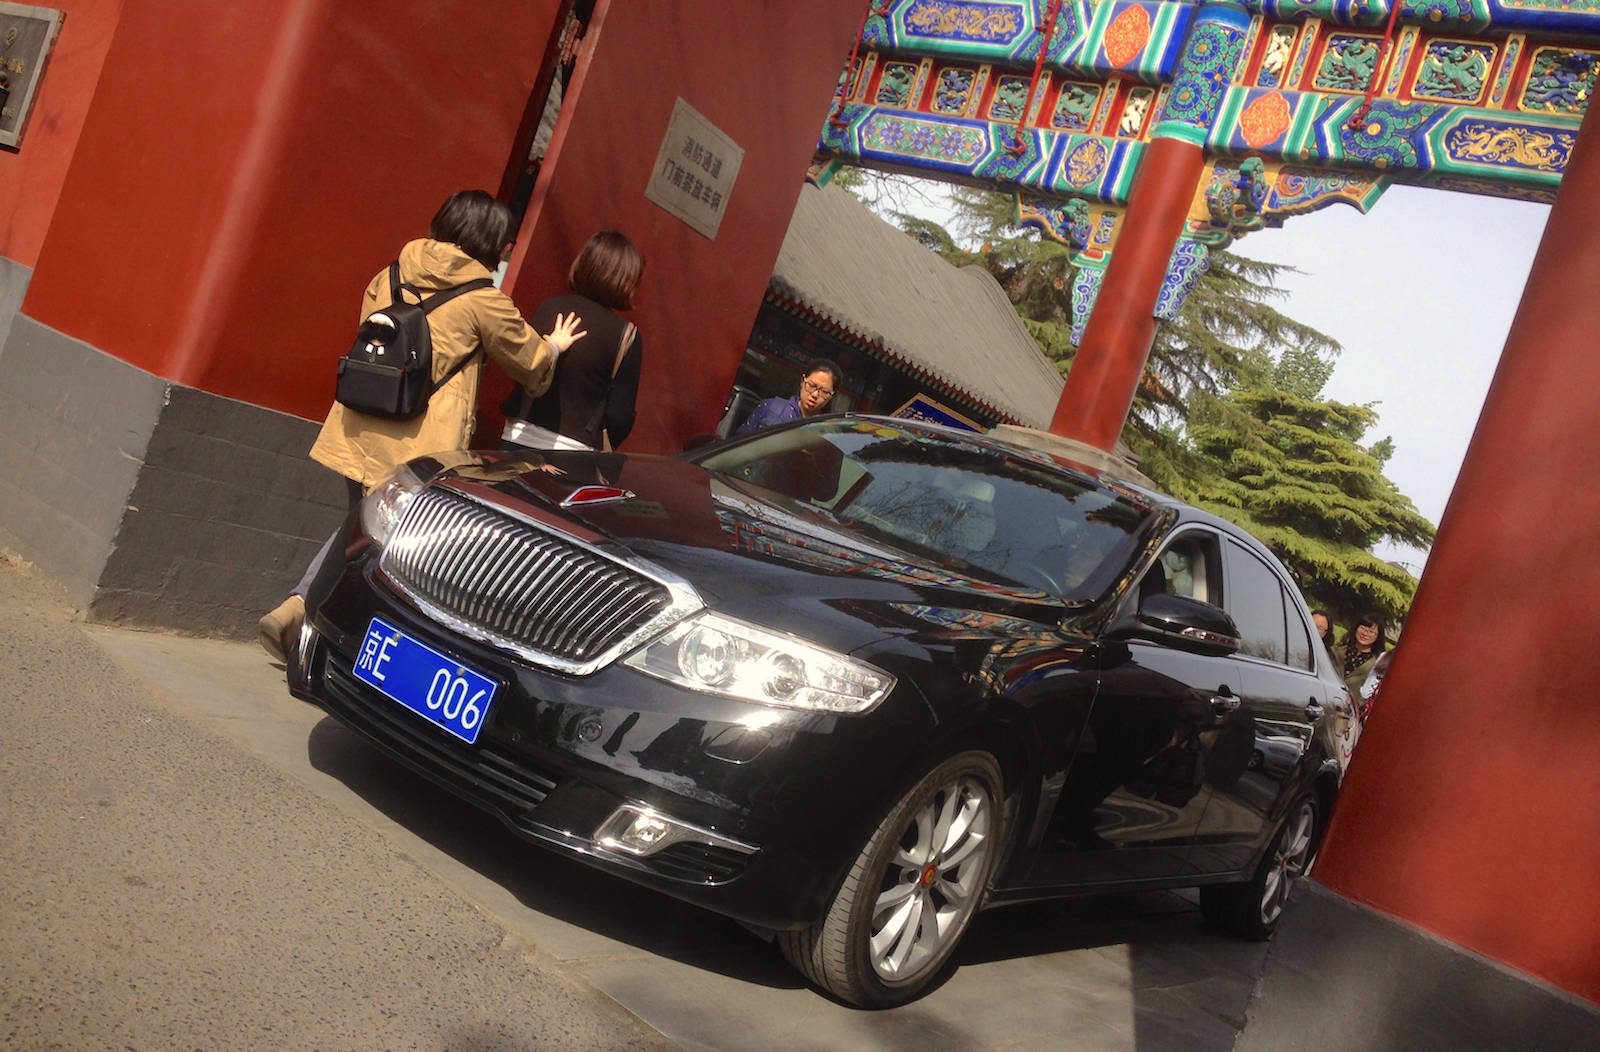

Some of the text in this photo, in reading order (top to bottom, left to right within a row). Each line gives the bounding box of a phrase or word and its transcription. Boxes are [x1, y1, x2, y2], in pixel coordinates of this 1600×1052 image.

[662, 157, 722, 213] 门前禁放车辆
[681, 135, 722, 179] 消防通道
[358, 630, 486, 729] 京E 006
